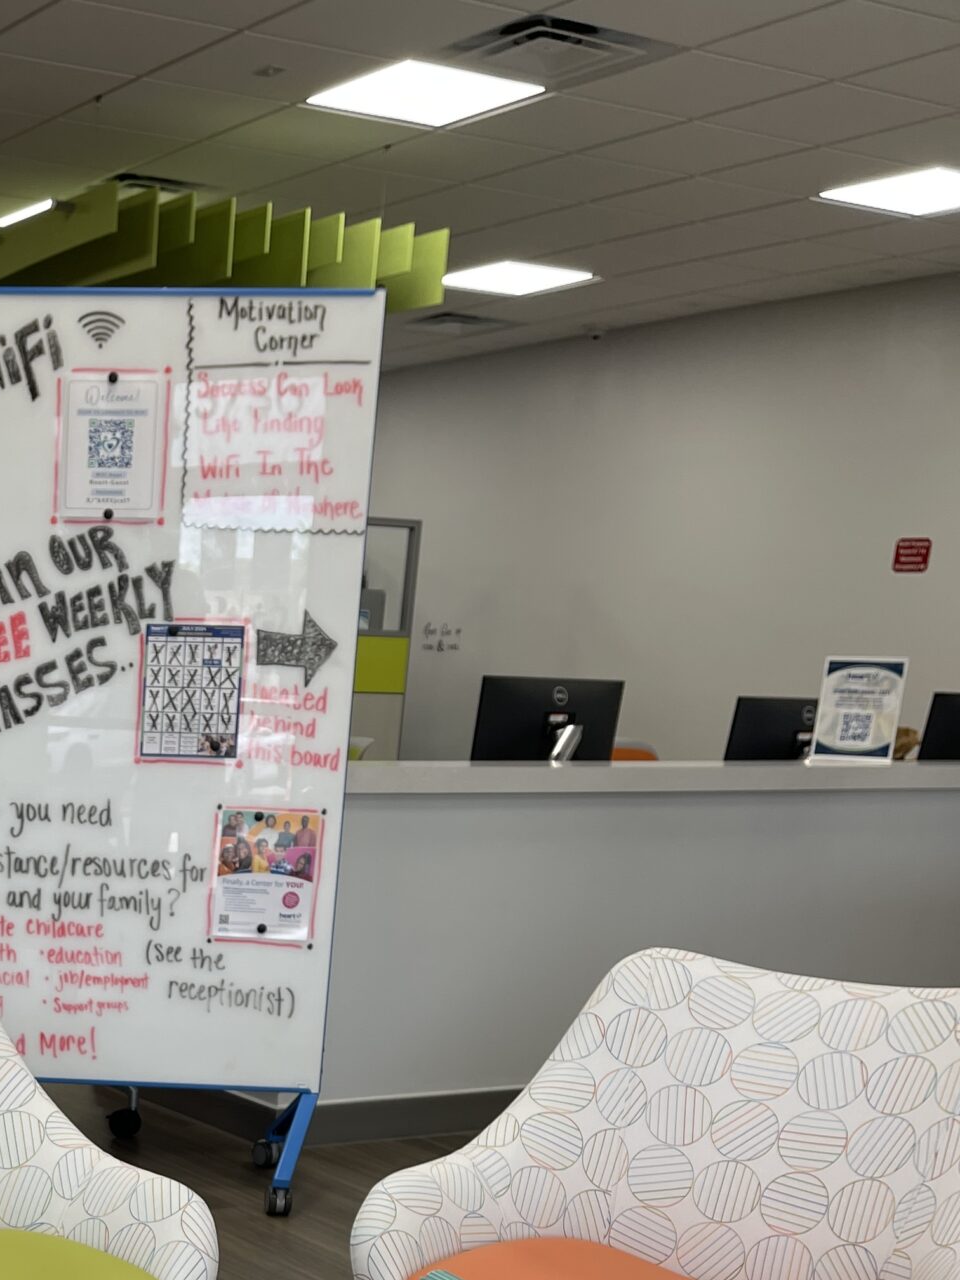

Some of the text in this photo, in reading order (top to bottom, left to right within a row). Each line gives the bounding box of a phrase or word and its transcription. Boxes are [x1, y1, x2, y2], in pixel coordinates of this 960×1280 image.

[219, 297, 326, 331] Motivation
[254, 327, 319, 356] Corner
[276, 372, 309, 398] Can
[323, 372, 363, 407] Look
[256, 450, 282, 475] In
[294, 448, 333, 484] The
[49, 525, 129, 576] OUR
[38, 559, 176, 643] WEEKLY
[290, 744, 340, 771] board
[11, 801, 50, 837] you
[62, 798, 111, 828] need
[179, 854, 207, 893] for
[7, 888, 41, 911] and
[52, 889, 91, 922] your
[99, 884, 180, 931] family?
[47, 947, 122, 967] education
[190, 948, 226, 971] the
[56, 970, 149, 993] job/employment
[168, 980, 296, 1018] receptionist)
[96, 1004, 128, 1016] groups
